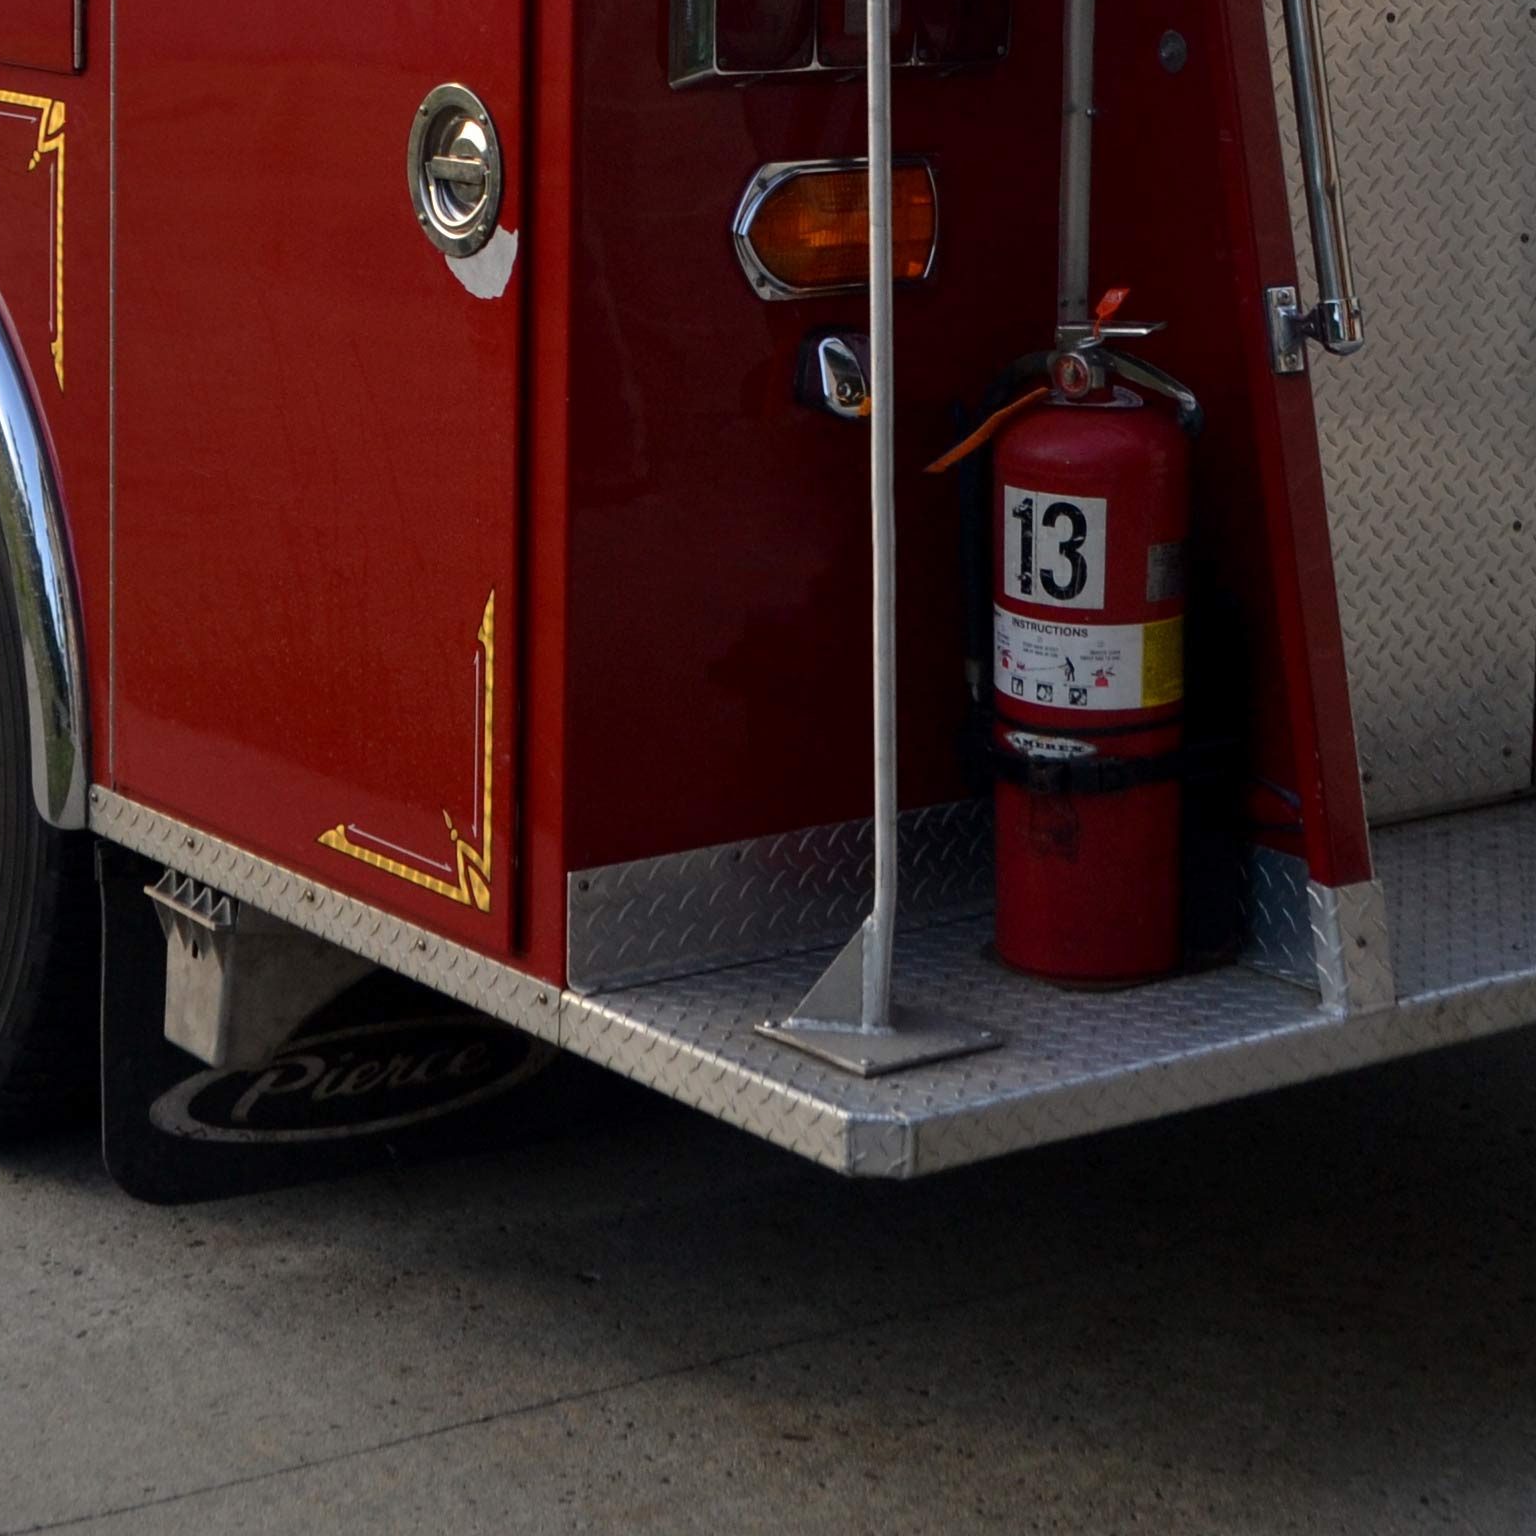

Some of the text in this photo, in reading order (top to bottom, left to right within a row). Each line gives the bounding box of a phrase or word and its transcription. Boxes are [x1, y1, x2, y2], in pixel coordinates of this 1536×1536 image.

[1011, 496, 1088, 601] 13
[1011, 617, 1089, 638] INSTRUCTIONS
[1012, 735, 1084, 753] AMEREX
[231, 1041, 492, 1121] Pierce
